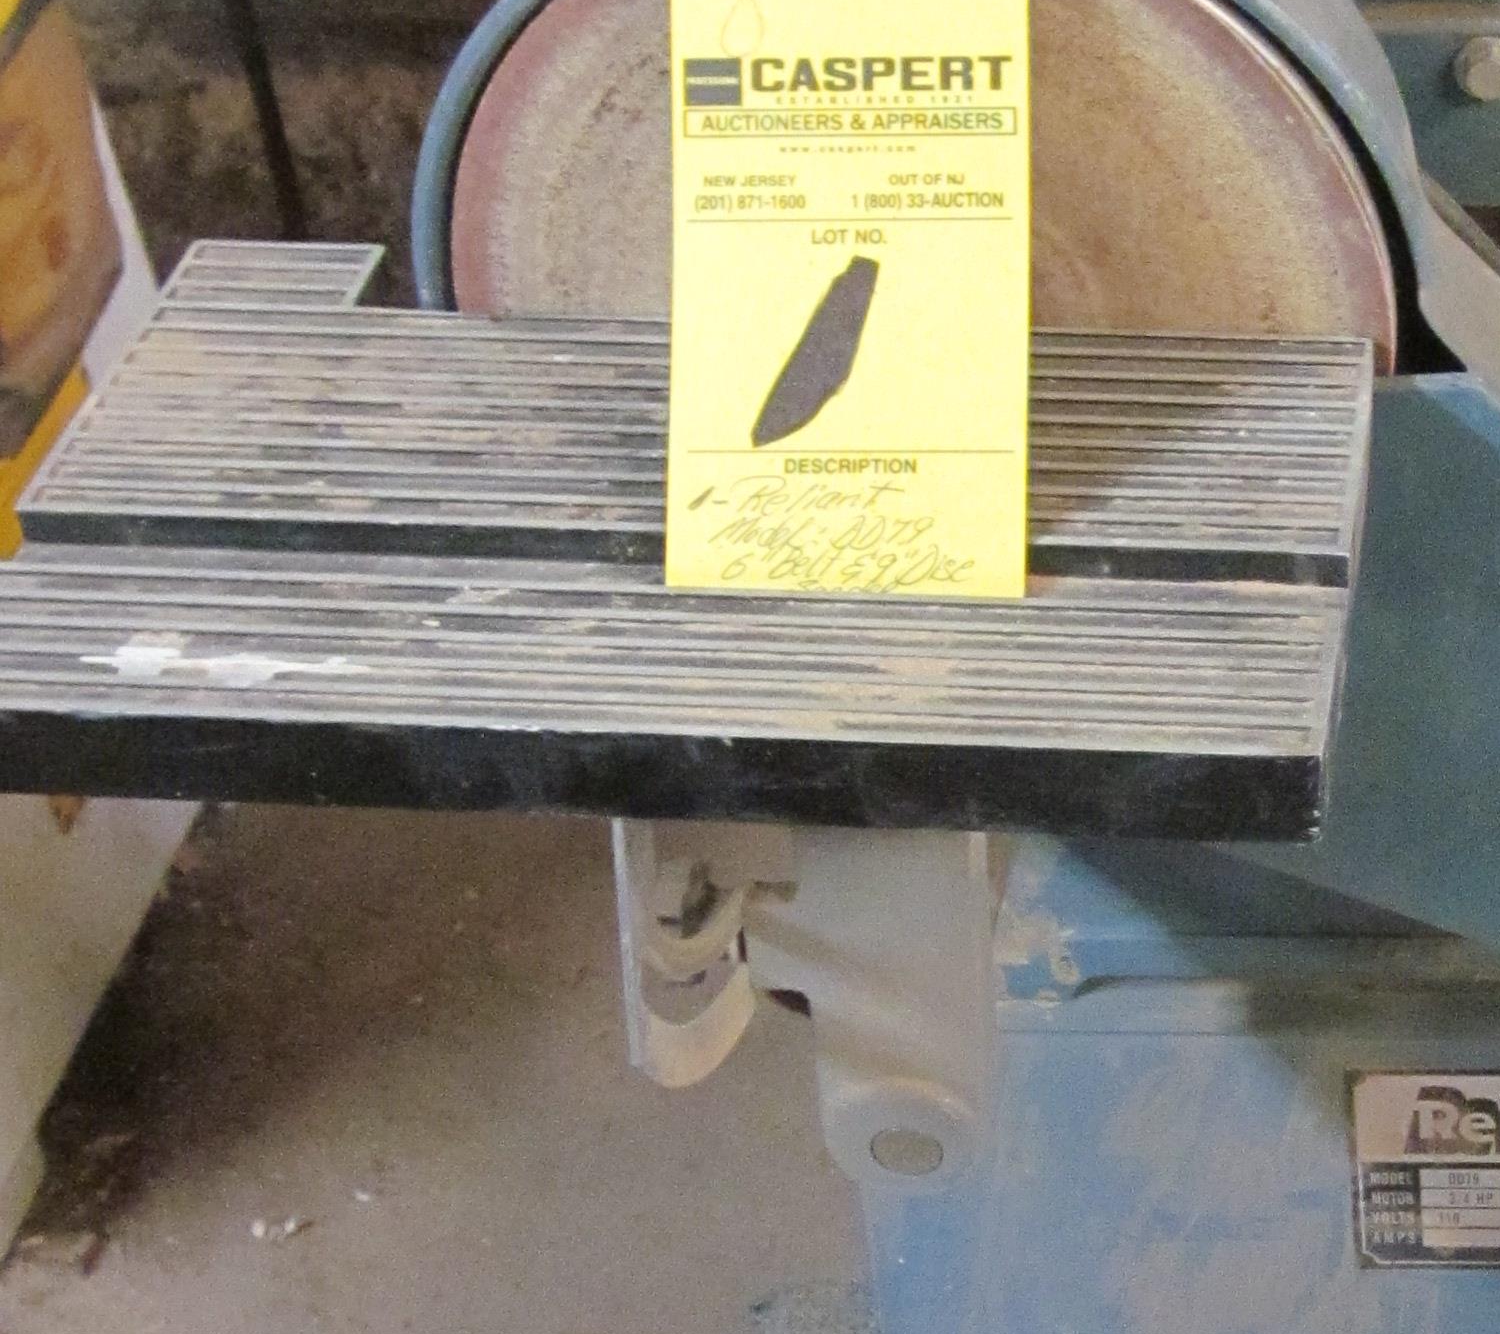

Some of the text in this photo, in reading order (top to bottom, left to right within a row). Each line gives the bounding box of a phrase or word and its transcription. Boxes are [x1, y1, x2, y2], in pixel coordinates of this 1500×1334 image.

[751, 56, 1012, 92] CASPERT
[776, 95, 915, 105] ESTABLISHED
[701, 112, 1003, 132] AUCTIONEERS & APPRAISERS
[703, 175, 796, 187] NEW JERSEY
[888, 173, 965, 186] OUT OF NJ
[695, 194, 806, 213] (201) 871-1600
[852, 192, 1004, 212] 1 (800) 33-AUCTION
[811, 229, 887, 245] LOT NO.
[784, 457, 917, 475] DESCRIPTION
[1369, 1171, 1412, 1185] MODEL
[1371, 1191, 1415, 1205] MOTOR
[1371, 1211, 1416, 1225] VOLTS
